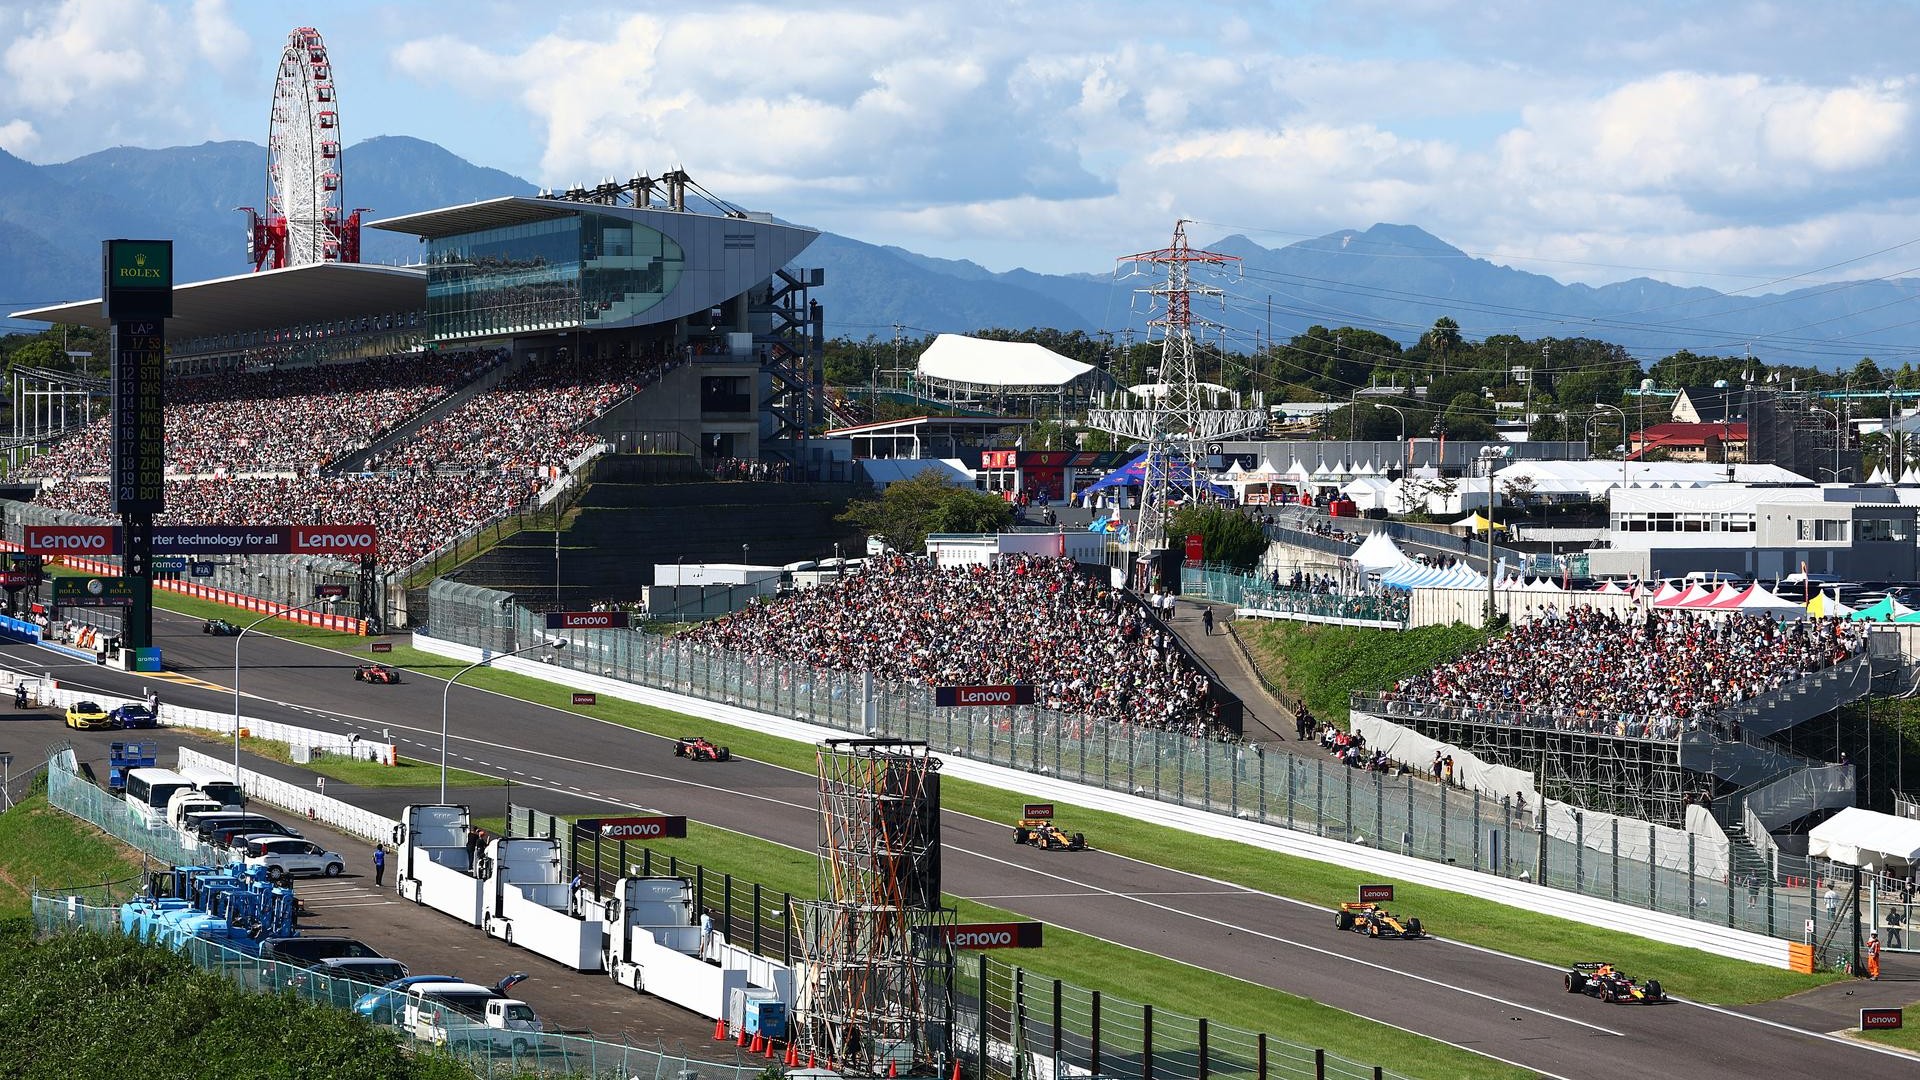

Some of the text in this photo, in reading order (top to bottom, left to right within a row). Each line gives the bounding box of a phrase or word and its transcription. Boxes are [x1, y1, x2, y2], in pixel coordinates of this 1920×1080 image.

[120, 268, 160, 277] ROLEX
[130, 323, 154, 334] LAP
[122, 352, 160, 365] 11 LAW
[122, 367, 160, 380] 12 STR
[122, 382, 160, 394] 13 GAS
[122, 397, 160, 410] 14 HUL
[122, 412, 160, 424] 15 MAG
[122, 427, 160, 440] 16 ALB
[122, 442, 160, 454] 17 SAR
[122, 457, 160, 470] 18 ZHO
[122, 472, 134, 484] 19
[122, 487, 160, 500] 20 BOT
[30, 532, 106, 549] Lenovo
[152, 534, 278, 547] rter technology for all
[298, 532, 372, 548] Lenovo
[566, 616, 608, 625] Lenovo
[961, 690, 1011, 702] Lenovo
